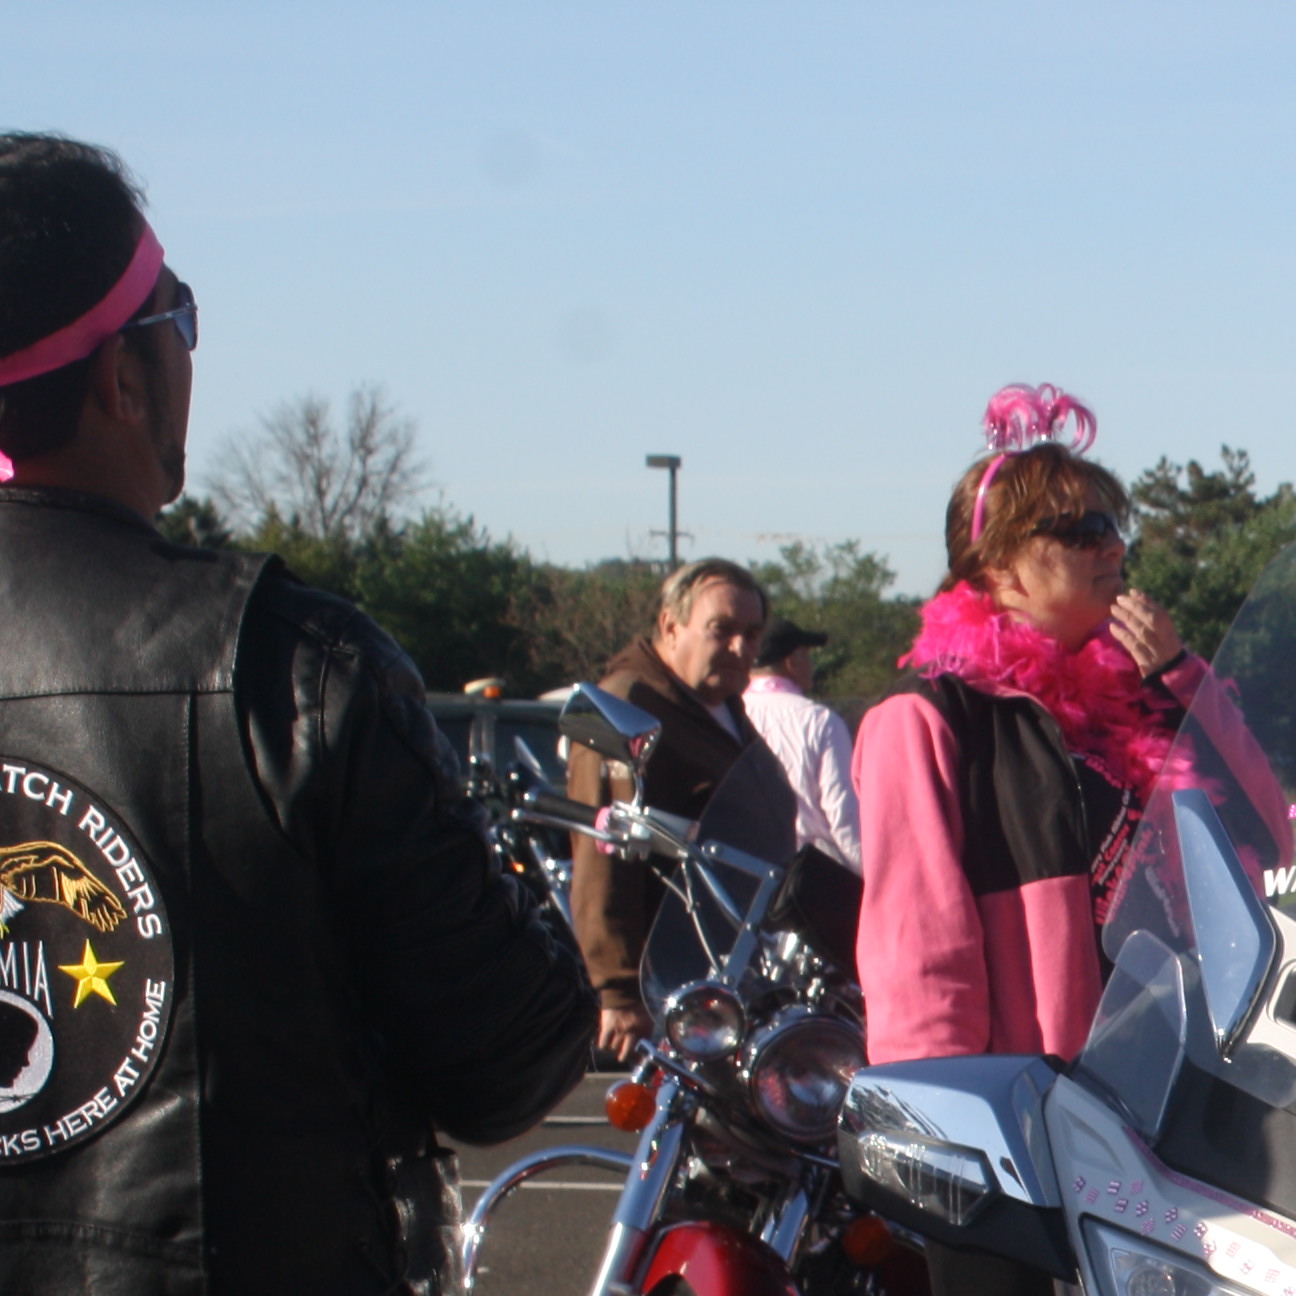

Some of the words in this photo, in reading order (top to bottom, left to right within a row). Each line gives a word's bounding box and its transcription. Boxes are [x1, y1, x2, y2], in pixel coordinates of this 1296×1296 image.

[78, 805, 162, 939] RIDERS
[43, 1086, 117, 1145] HERE
[113, 1056, 140, 1097] AT
[131, 978, 166, 1062] HOME
